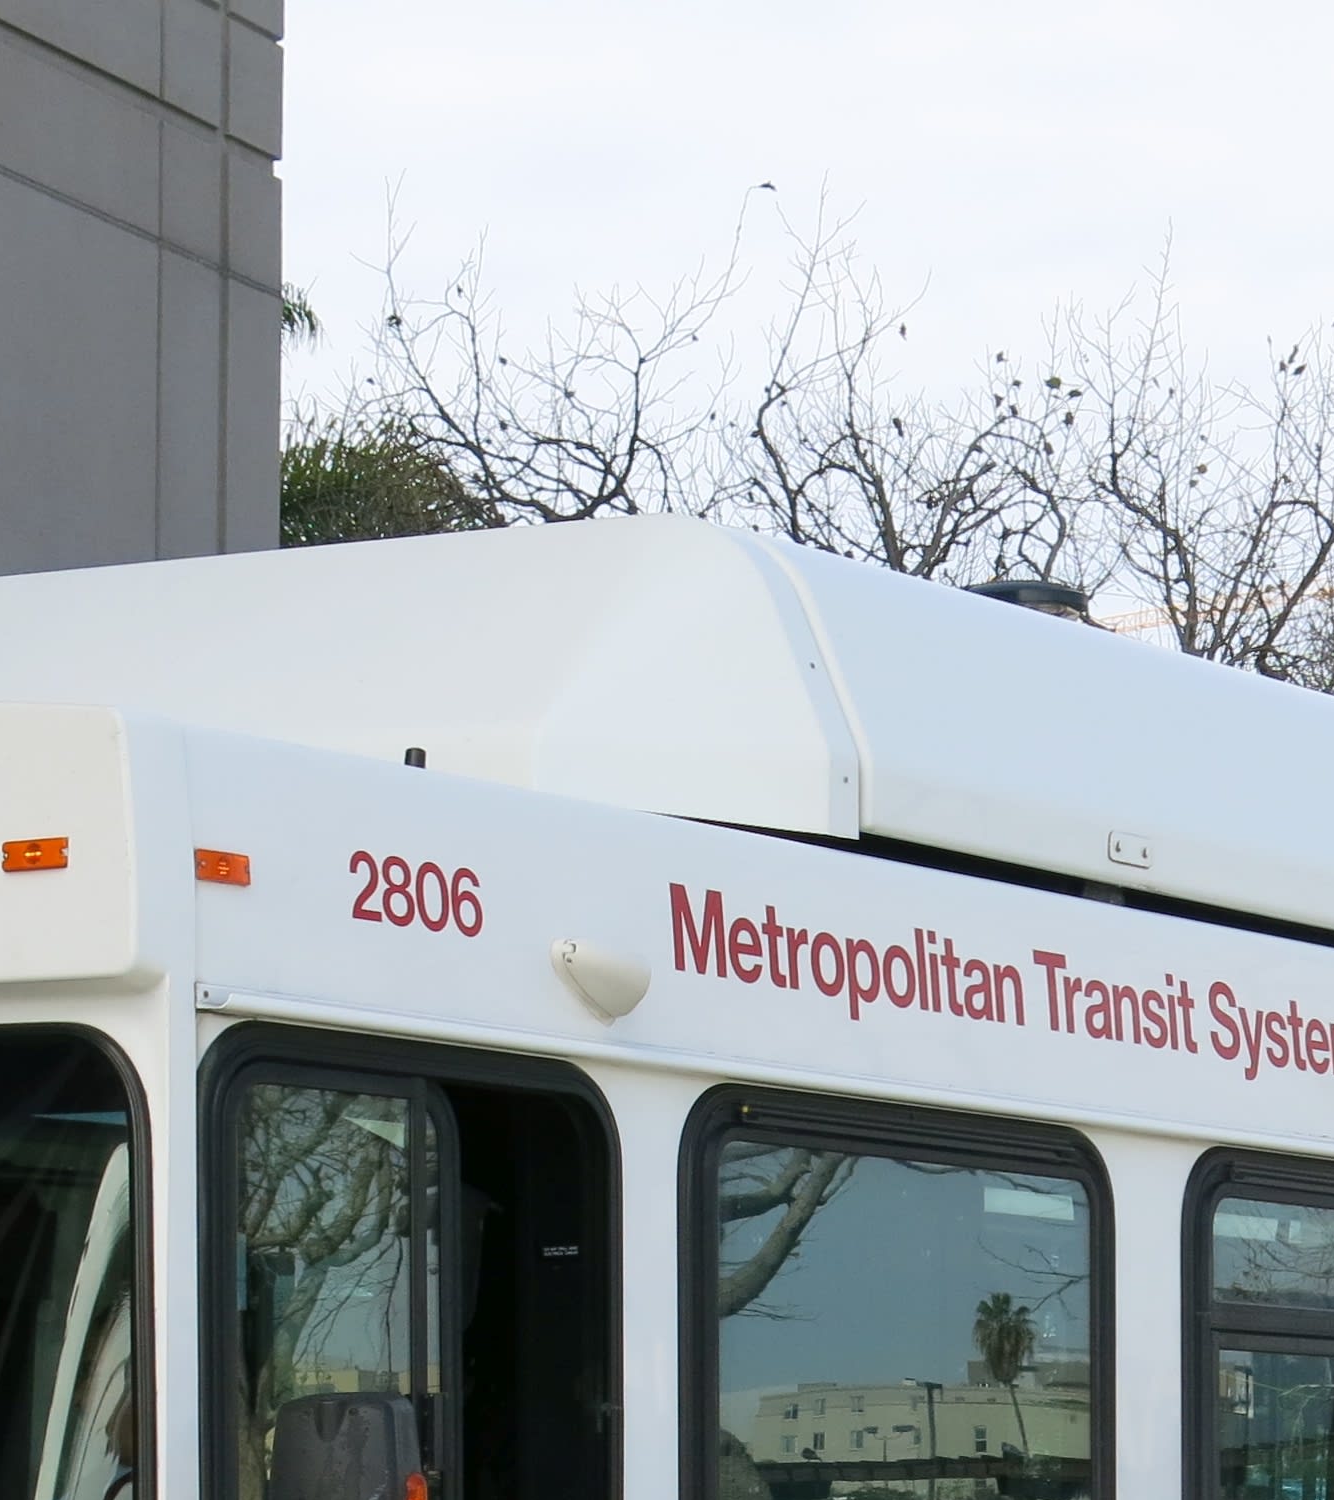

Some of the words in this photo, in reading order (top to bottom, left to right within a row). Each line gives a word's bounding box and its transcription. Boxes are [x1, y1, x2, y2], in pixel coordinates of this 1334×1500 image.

[349, 850, 483, 938] 2806
[669, 882, 1026, 1027] Metropolitan
[1033, 949, 1198, 1054] Transit
